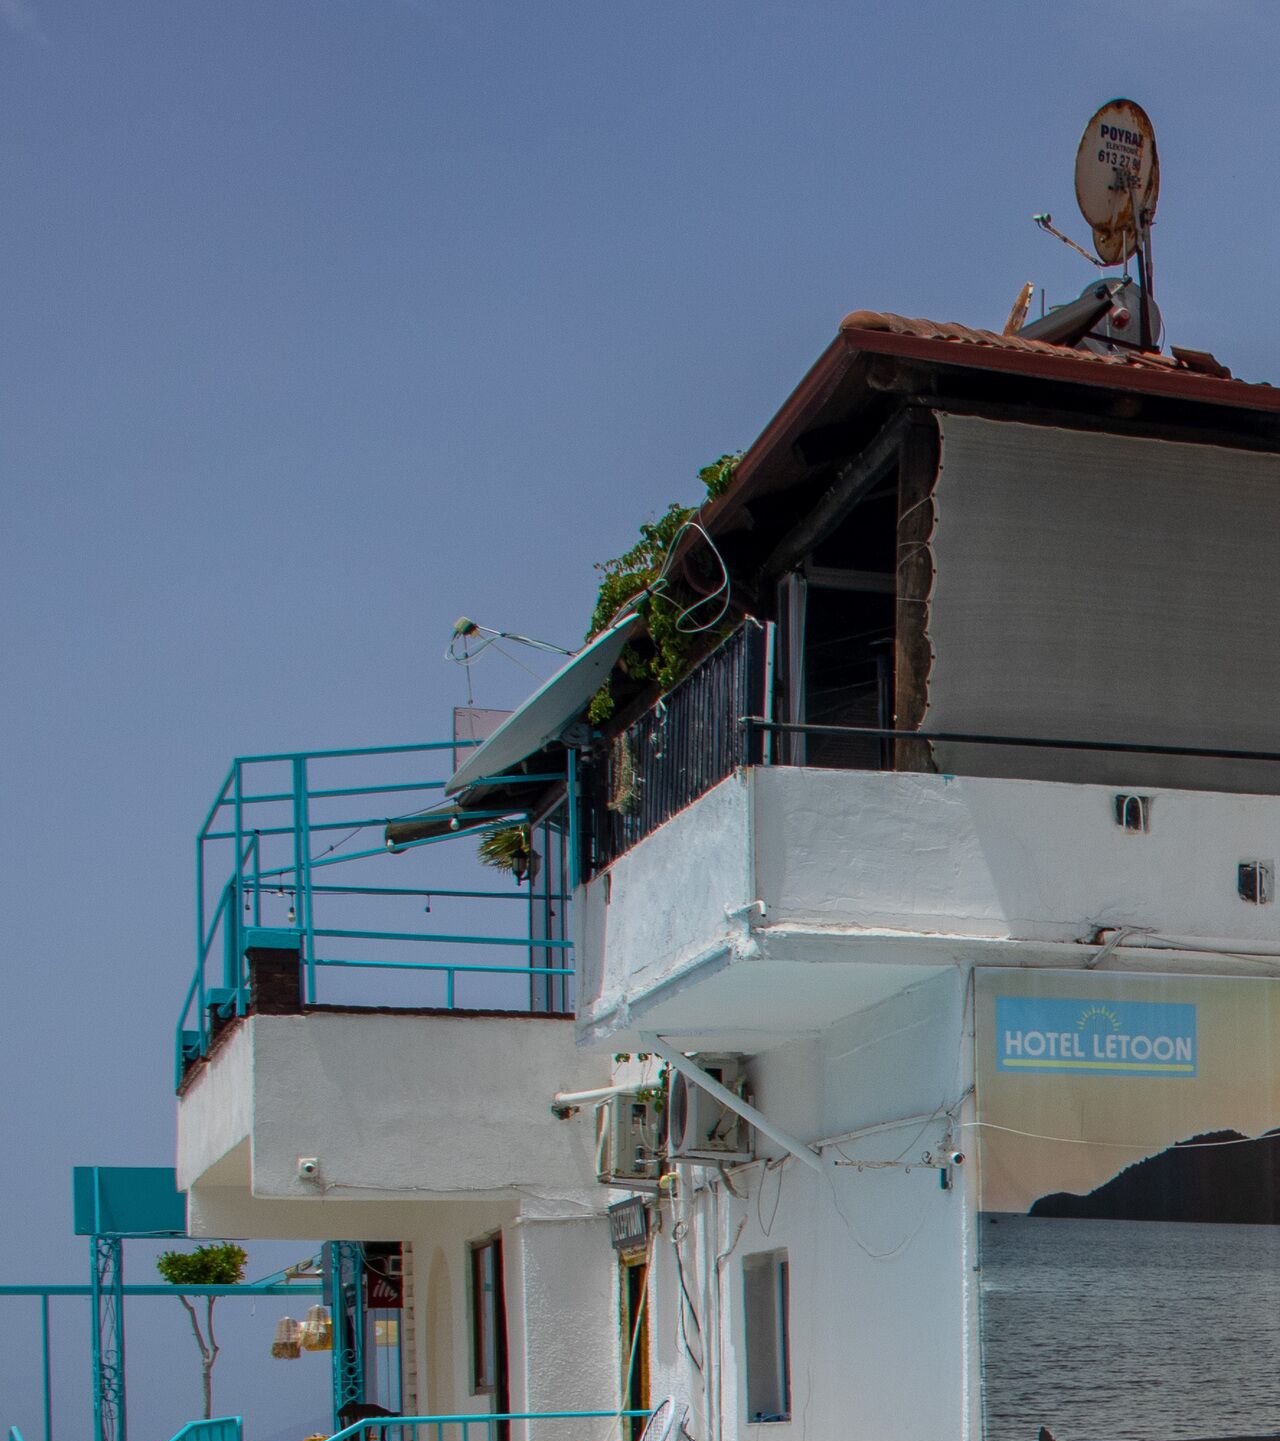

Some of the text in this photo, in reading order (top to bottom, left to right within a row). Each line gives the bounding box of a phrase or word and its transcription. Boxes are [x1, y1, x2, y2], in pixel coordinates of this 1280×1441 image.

[1098, 150, 1118, 165] 613
[1119, 155, 1131, 167] 27
[1005, 1030, 1192, 1061] HOTEL LETOON
[372, 1279, 398, 1302] illy
